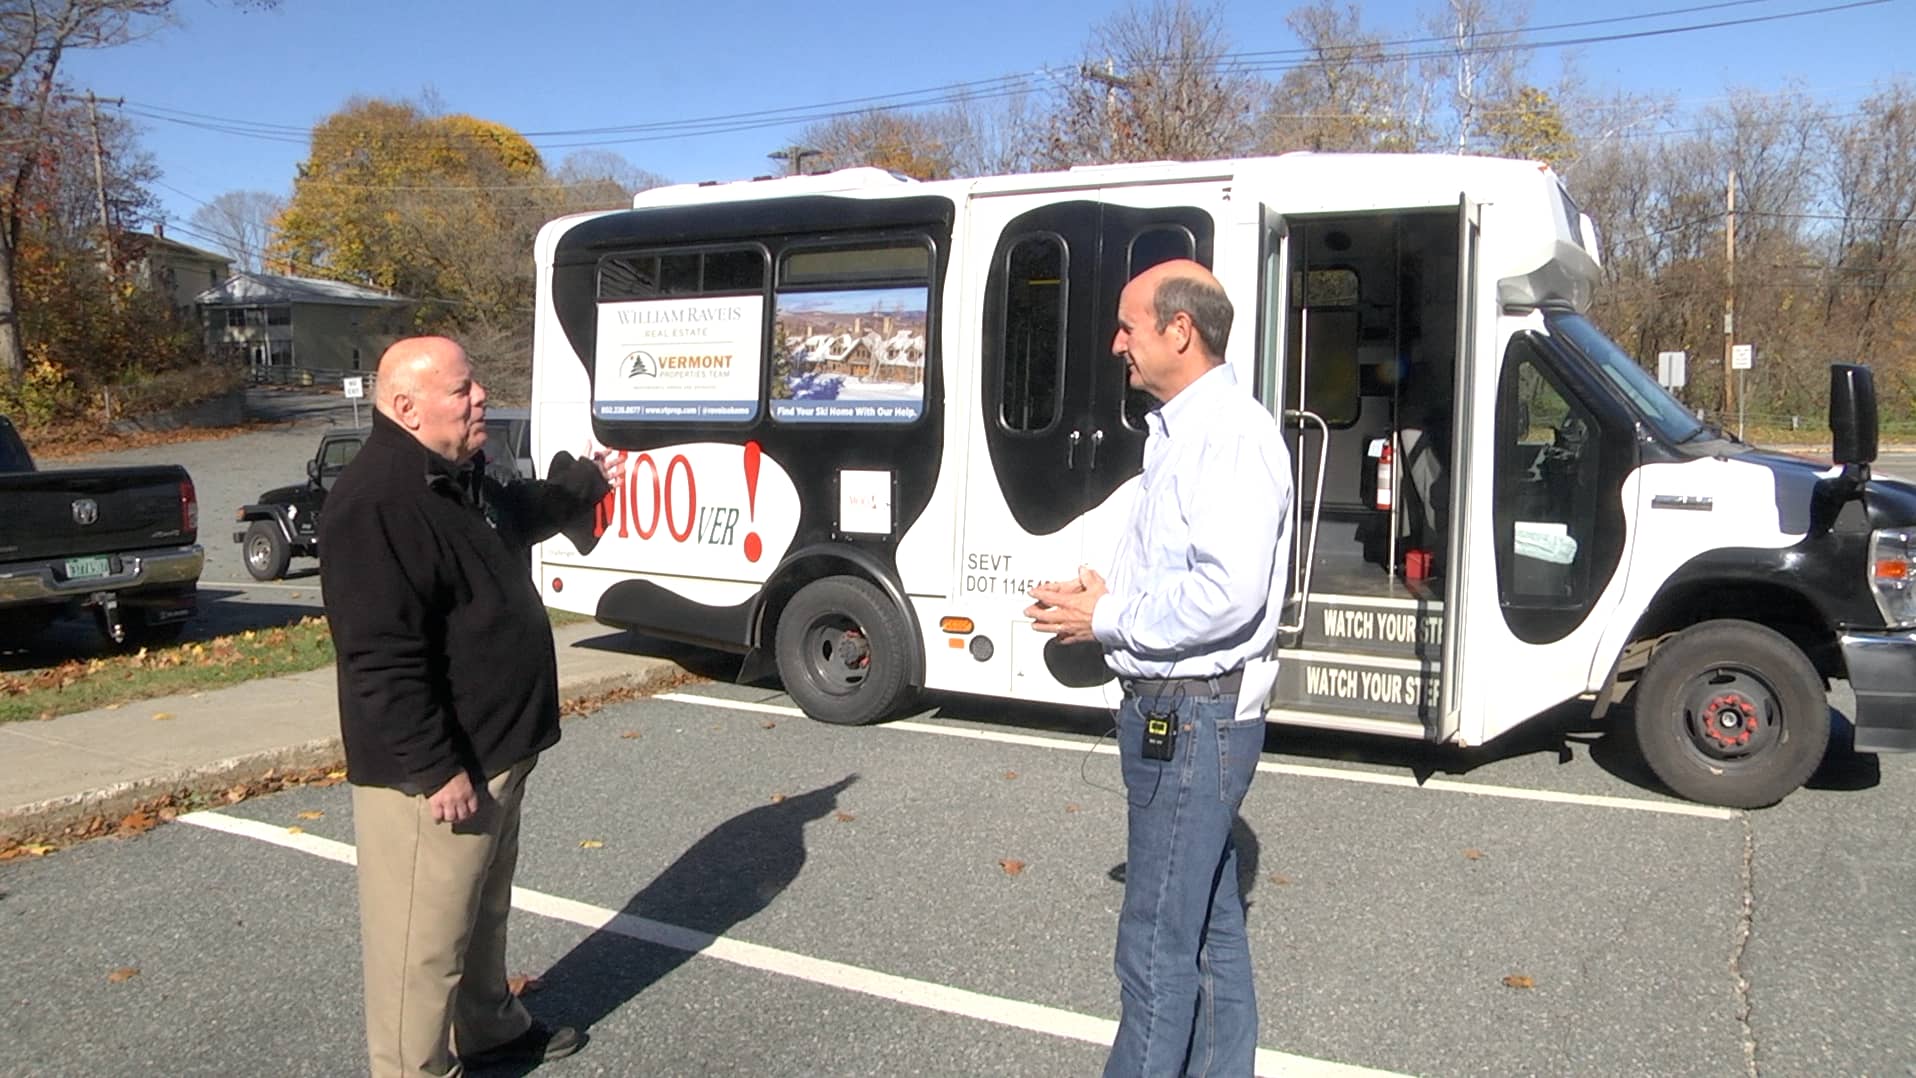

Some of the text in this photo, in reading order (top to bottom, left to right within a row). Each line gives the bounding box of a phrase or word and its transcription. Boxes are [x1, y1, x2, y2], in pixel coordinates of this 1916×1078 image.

[617, 307, 742, 325] WILLIAM RAVEIS
[645, 327, 708, 338] REAL ESTATE
[658, 354, 733, 369] VERMONT
[659, 369, 730, 379] PROPERTIES TEAM
[777, 406, 918, 418] Find Your Ski Home With Our Help.
[968, 553, 1012, 571] SEVT
[966, 575, 997, 592] DOT
[1324, 609, 1373, 639] WATCH
[1376, 613, 1416, 642] YOUR
[1307, 666, 1357, 699] WATCH
[1361, 671, 1401, 703] YOUR
